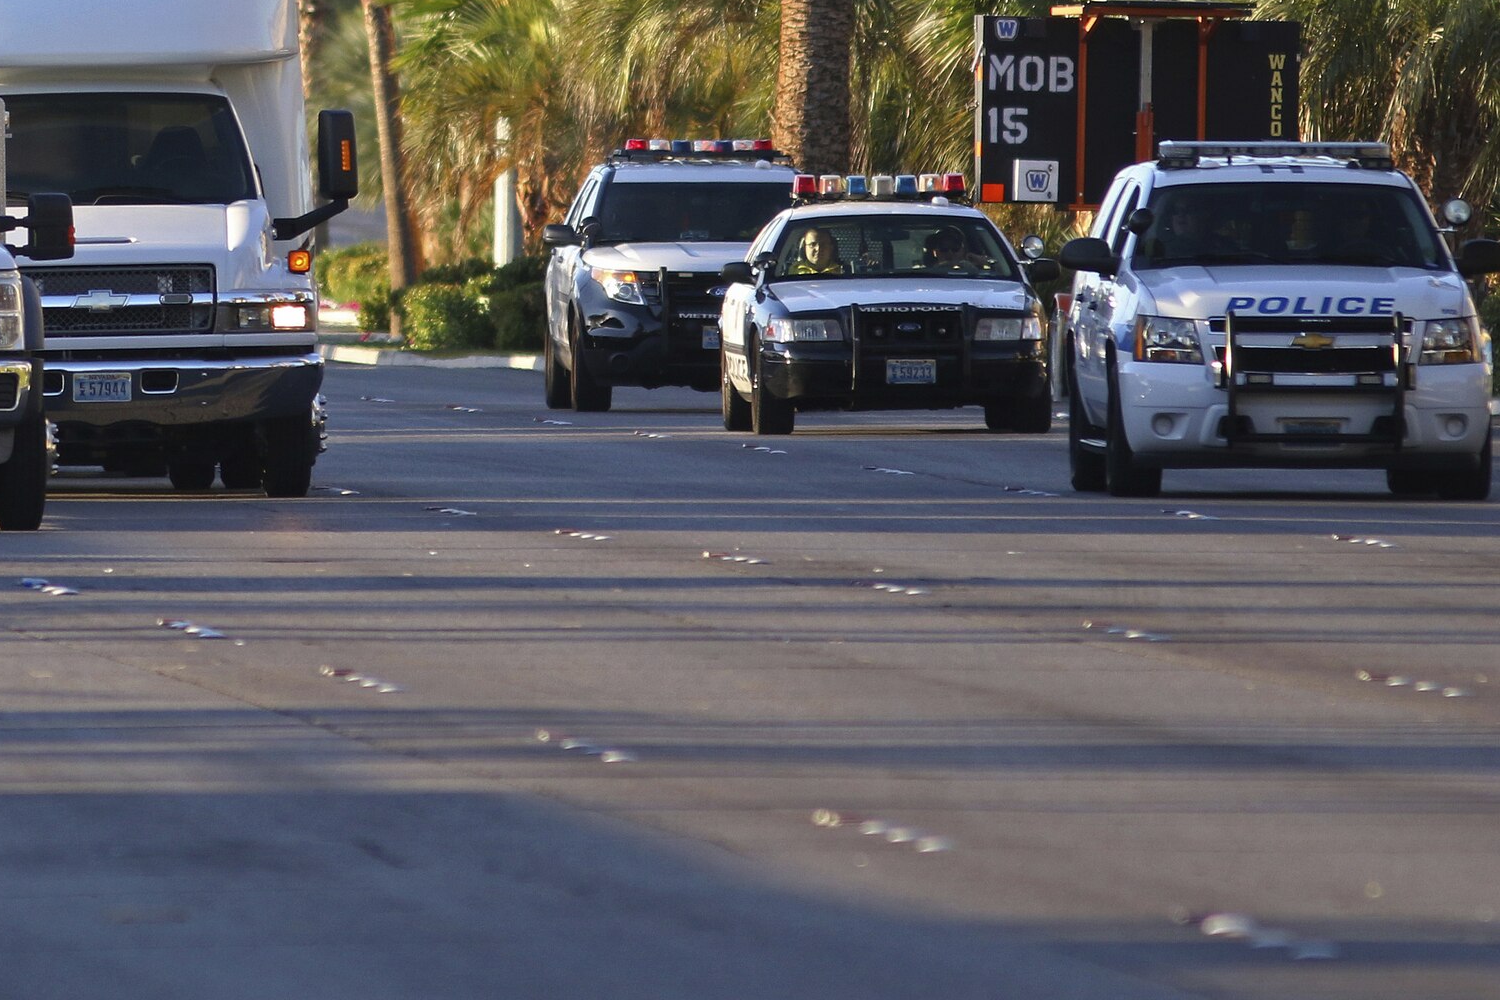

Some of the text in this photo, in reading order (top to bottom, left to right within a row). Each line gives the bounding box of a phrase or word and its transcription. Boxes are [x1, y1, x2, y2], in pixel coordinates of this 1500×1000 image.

[999, 20, 1017, 37] W
[988, 54, 1075, 93] MOB
[1268, 54, 1287, 137] WANCO
[988, 107, 1029, 144] 15
[1029, 173, 1047, 189] W
[1226, 296, 1396, 315] POLICE
[89, 381, 127, 396] 57944
